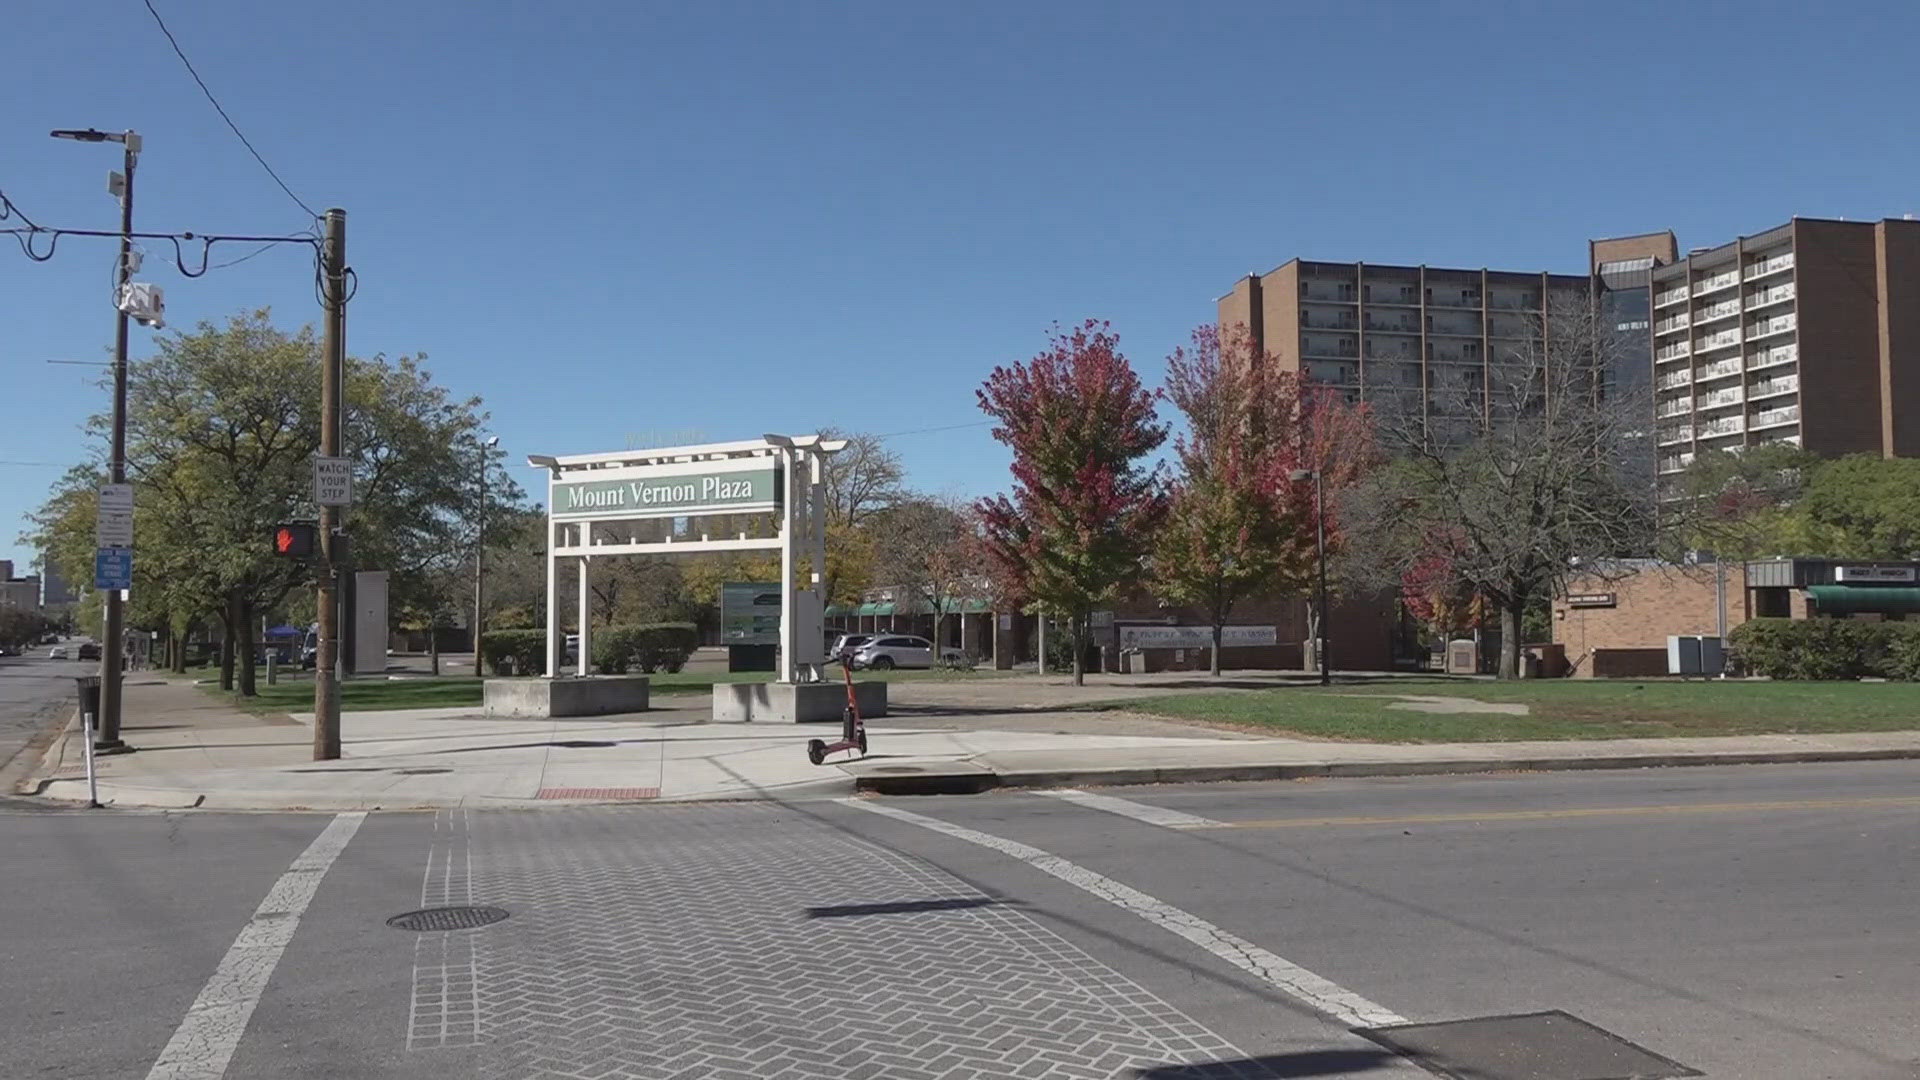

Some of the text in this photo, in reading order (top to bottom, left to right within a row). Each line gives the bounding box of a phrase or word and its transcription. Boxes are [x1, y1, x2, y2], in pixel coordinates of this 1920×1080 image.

[318, 463, 350, 474] WATCH
[320, 476, 347, 486] YOUR
[322, 488, 345, 498] STEP
[567, 476, 753, 508] Mount Vernon Plaza
